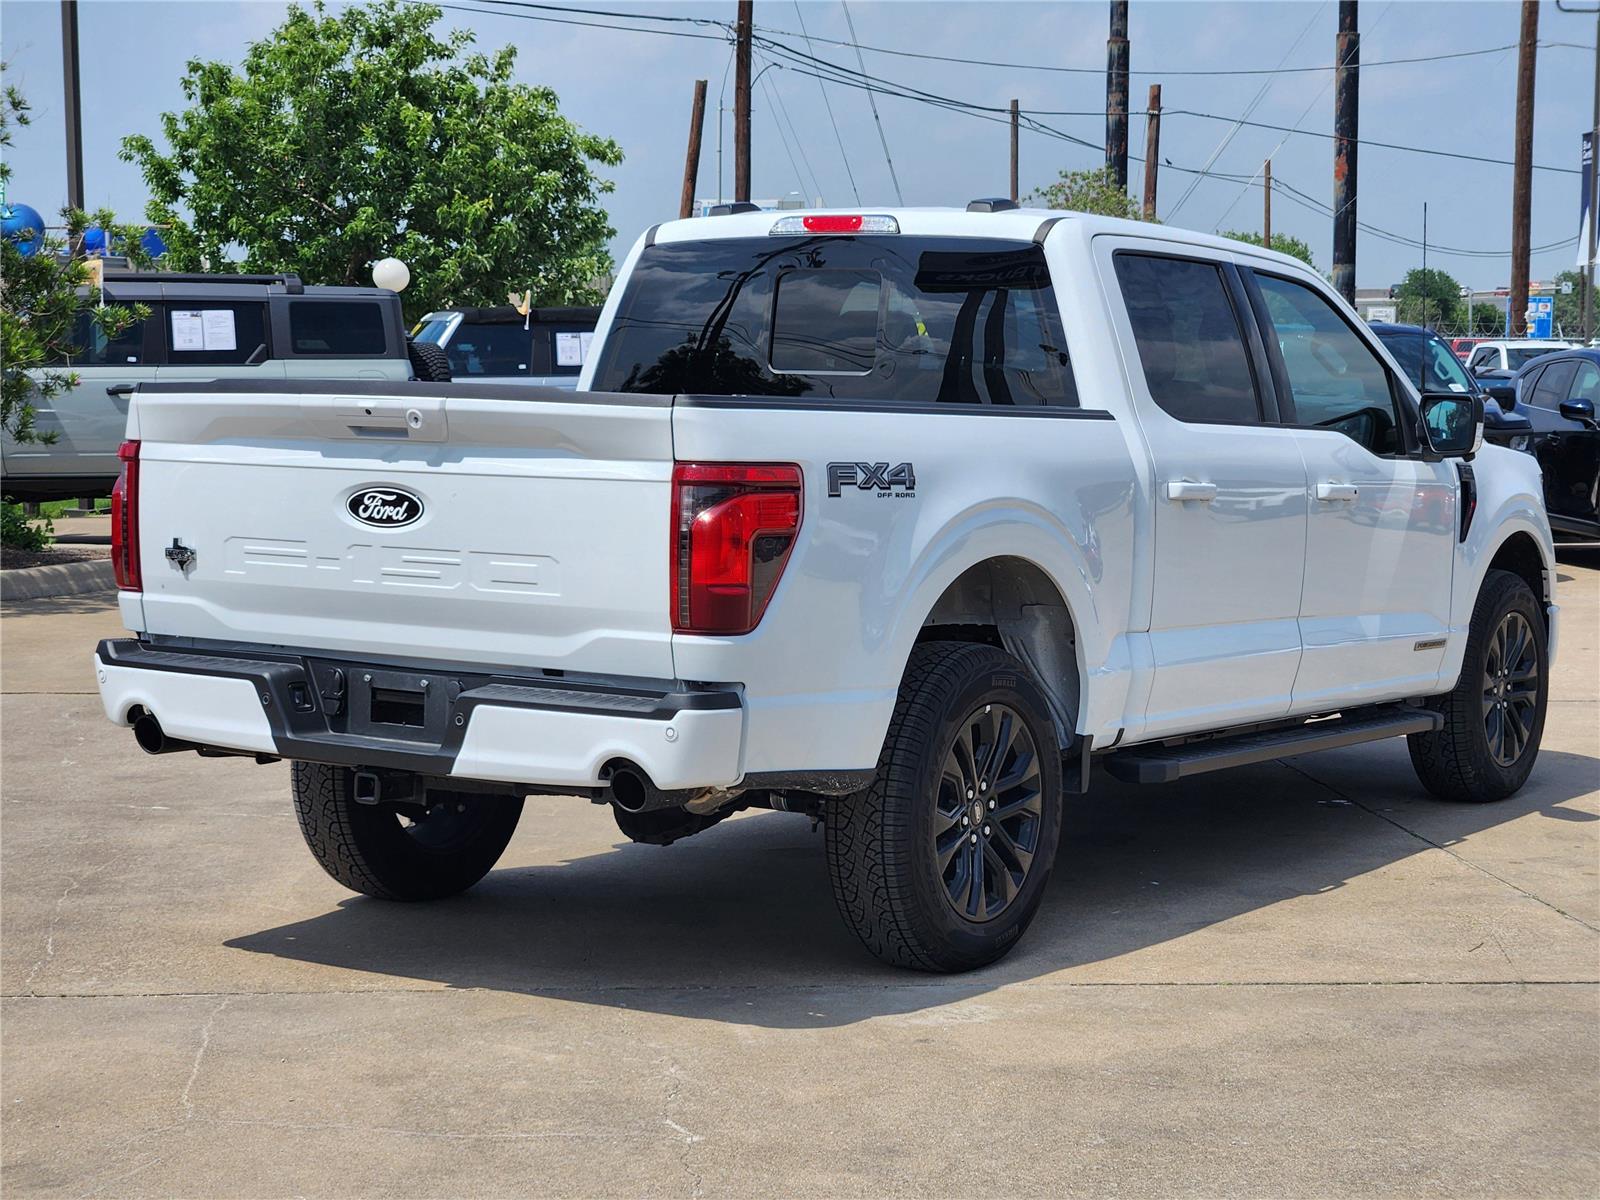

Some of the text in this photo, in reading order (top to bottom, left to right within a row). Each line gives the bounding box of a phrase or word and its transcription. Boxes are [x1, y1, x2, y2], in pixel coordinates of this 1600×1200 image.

[826, 462, 916, 498] FX4
[358, 492, 409, 521] Ford
[224, 536, 561, 597] F-150
